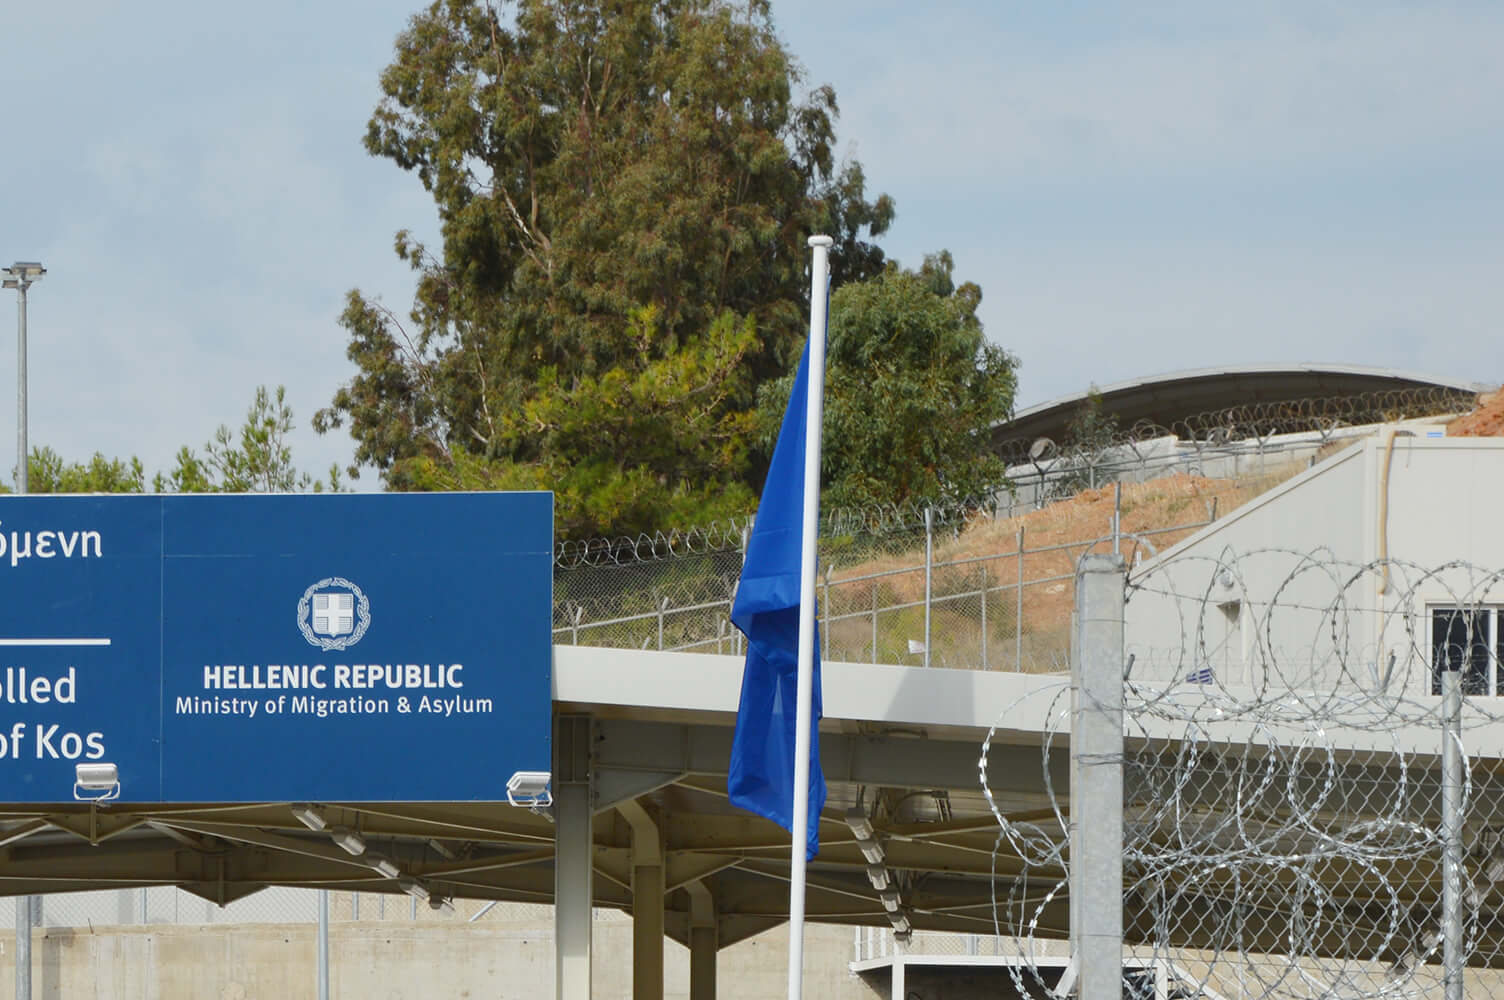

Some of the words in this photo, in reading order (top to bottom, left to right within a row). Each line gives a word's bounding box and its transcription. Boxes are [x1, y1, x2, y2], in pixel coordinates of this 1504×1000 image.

[204, 664, 327, 689] HELLENIC
[334, 664, 463, 689] REPUBLIC
[175, 696, 258, 718] Ministry
[265, 695, 286, 714] of
[291, 695, 389, 718] Migration
[397, 696, 412, 713] &
[418, 695, 492, 717] Asylum
[37, 724, 103, 760] Kos
